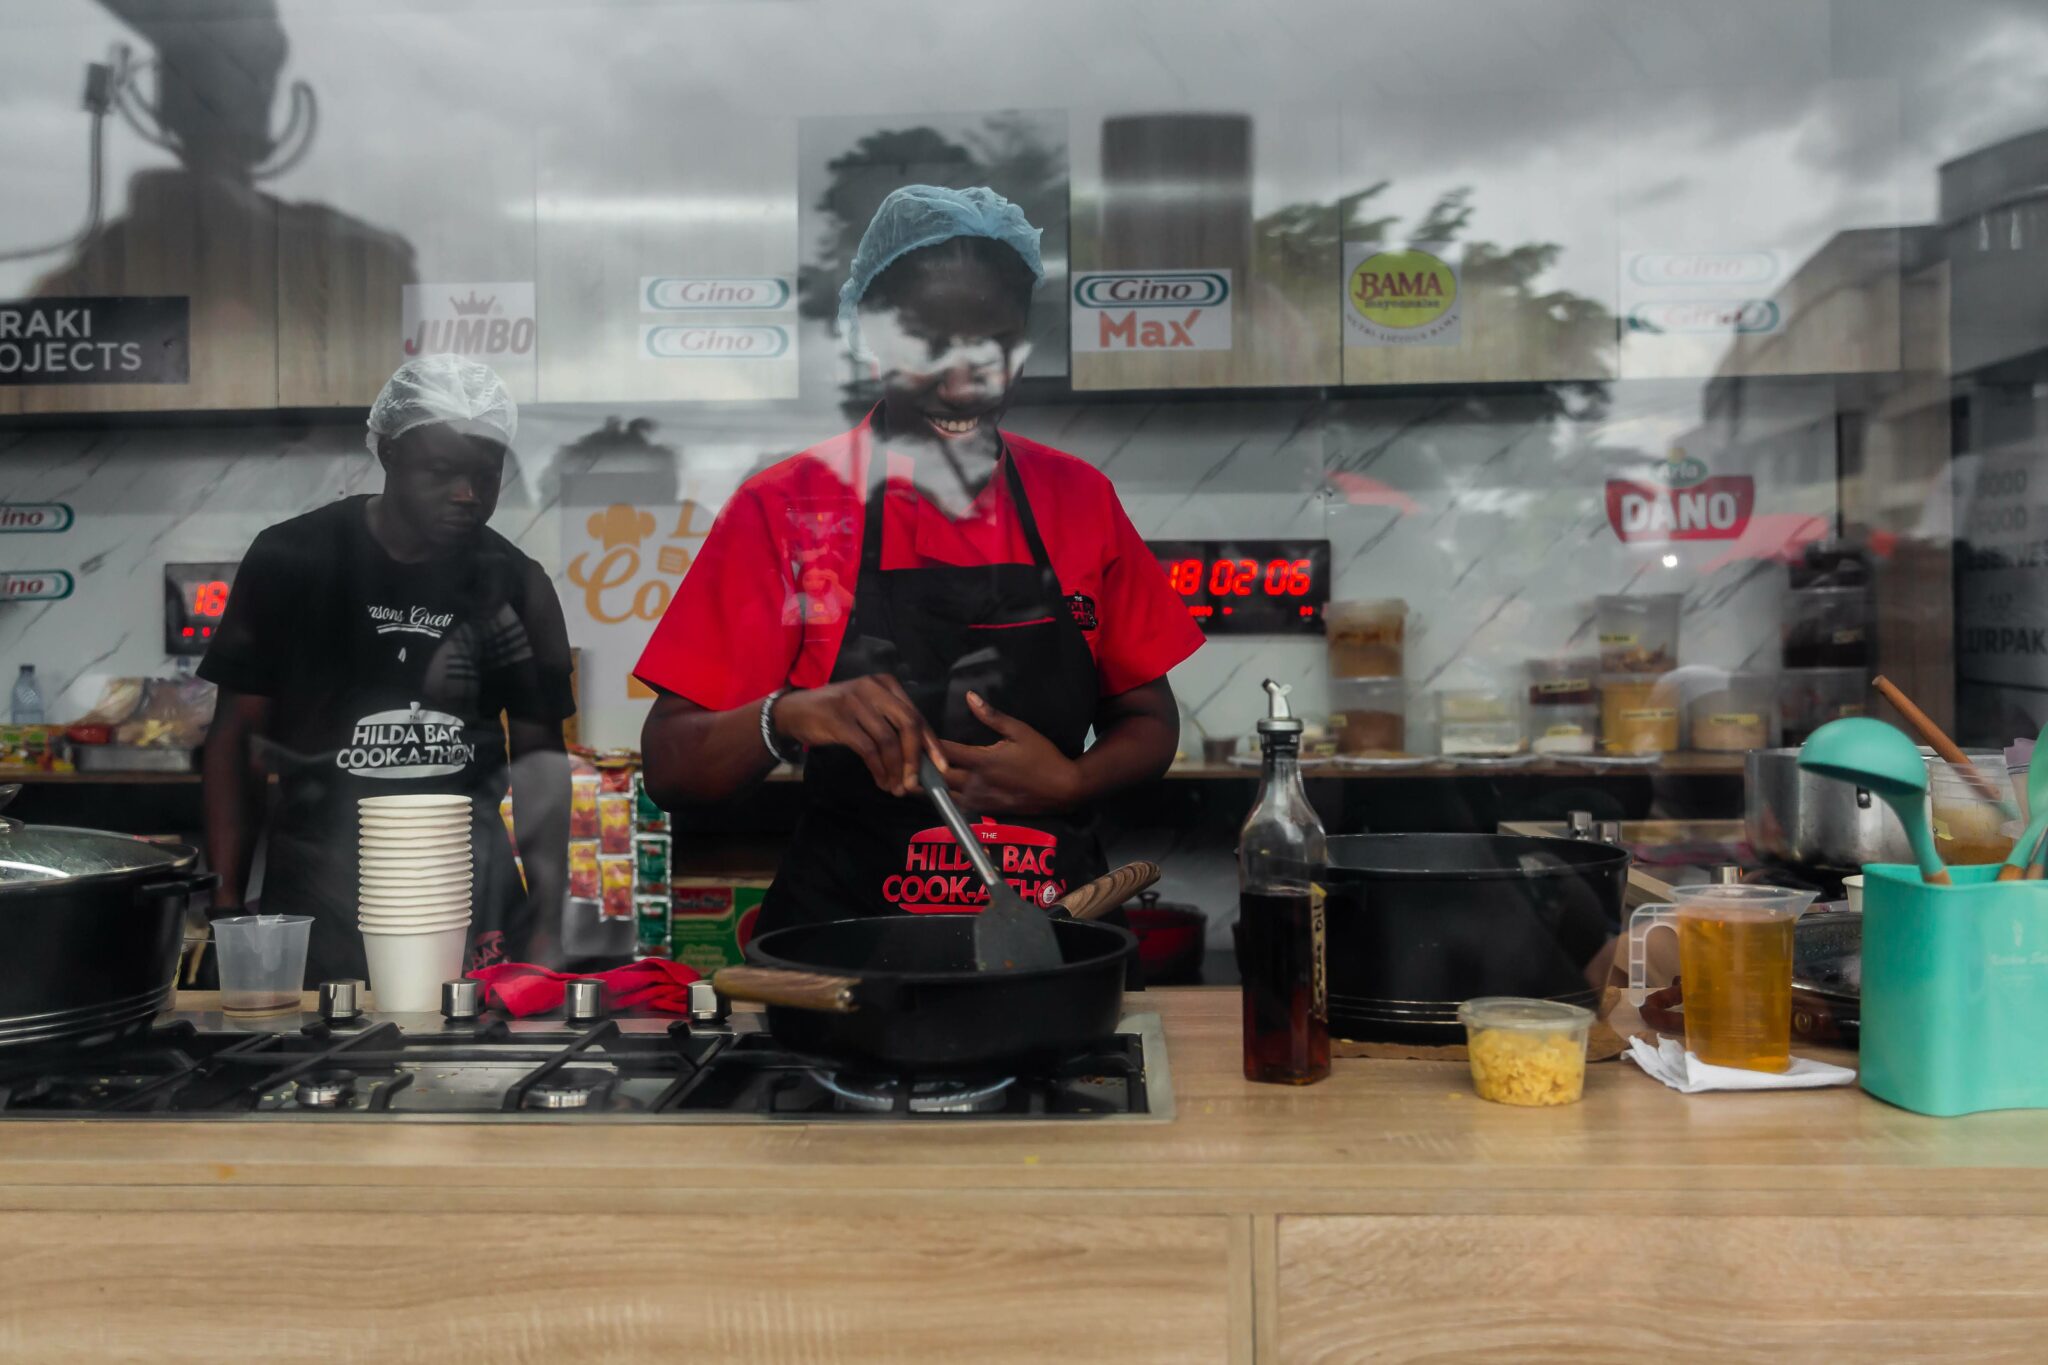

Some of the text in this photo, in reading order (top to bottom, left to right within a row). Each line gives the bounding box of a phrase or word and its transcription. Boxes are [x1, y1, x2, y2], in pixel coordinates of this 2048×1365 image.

[680, 281, 755, 302] Gino
[1108, 279, 1193, 301] Gino
[1354, 271, 1444, 300] BAMA
[0, 309, 92, 338] RAKI
[404, 317, 535, 356] JUMBO
[1098, 308, 1202, 348] Max
[680, 329, 755, 351] Gino
[0, 341, 142, 373] OJECTS
[1620, 491, 1737, 532] DANO
[1209, 559, 1258, 595] 02
[1264, 559, 1311, 595] 06
[352, 725, 420, 746] HILDA
[336, 743, 475, 768] COOK-A-THON
[905, 844, 1000, 872] HILD
